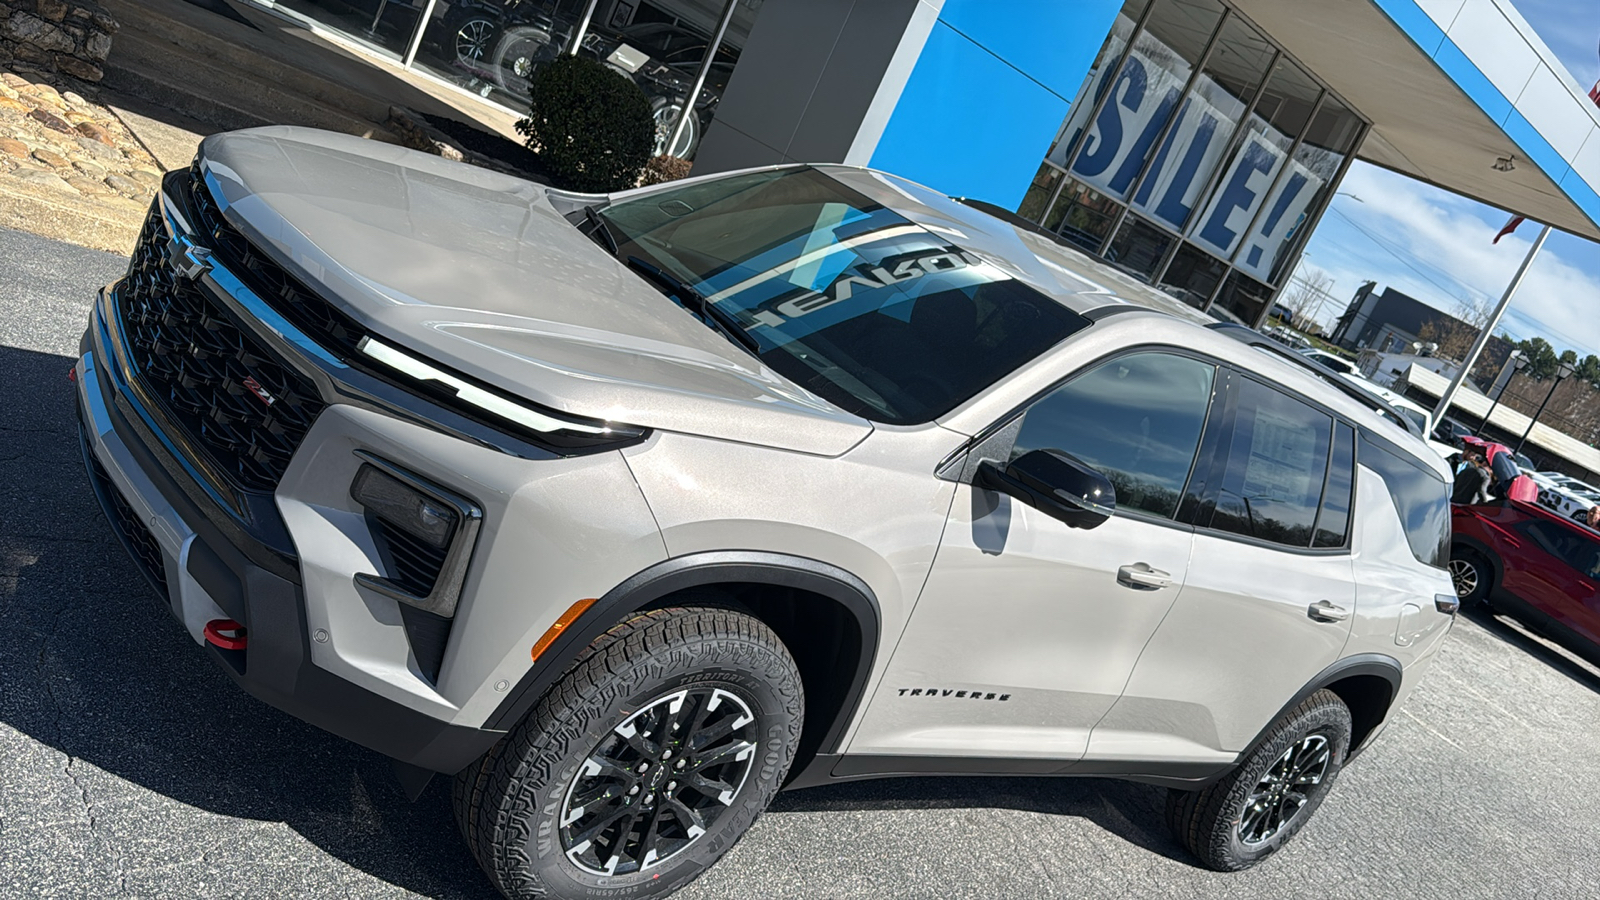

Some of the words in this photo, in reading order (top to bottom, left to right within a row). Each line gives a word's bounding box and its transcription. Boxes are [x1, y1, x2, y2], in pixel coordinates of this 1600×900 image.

[1067, 54, 1308, 268] SALE!
[243, 376, 275, 406] Z71
[680, 672, 745, 685] TERRITORY
[745, 680, 760, 690] AT
[898, 688, 1012, 702] TRAVERSE
[706, 724, 783, 854] GOODYEAR
[586, 886, 639, 896] 265/65R18
